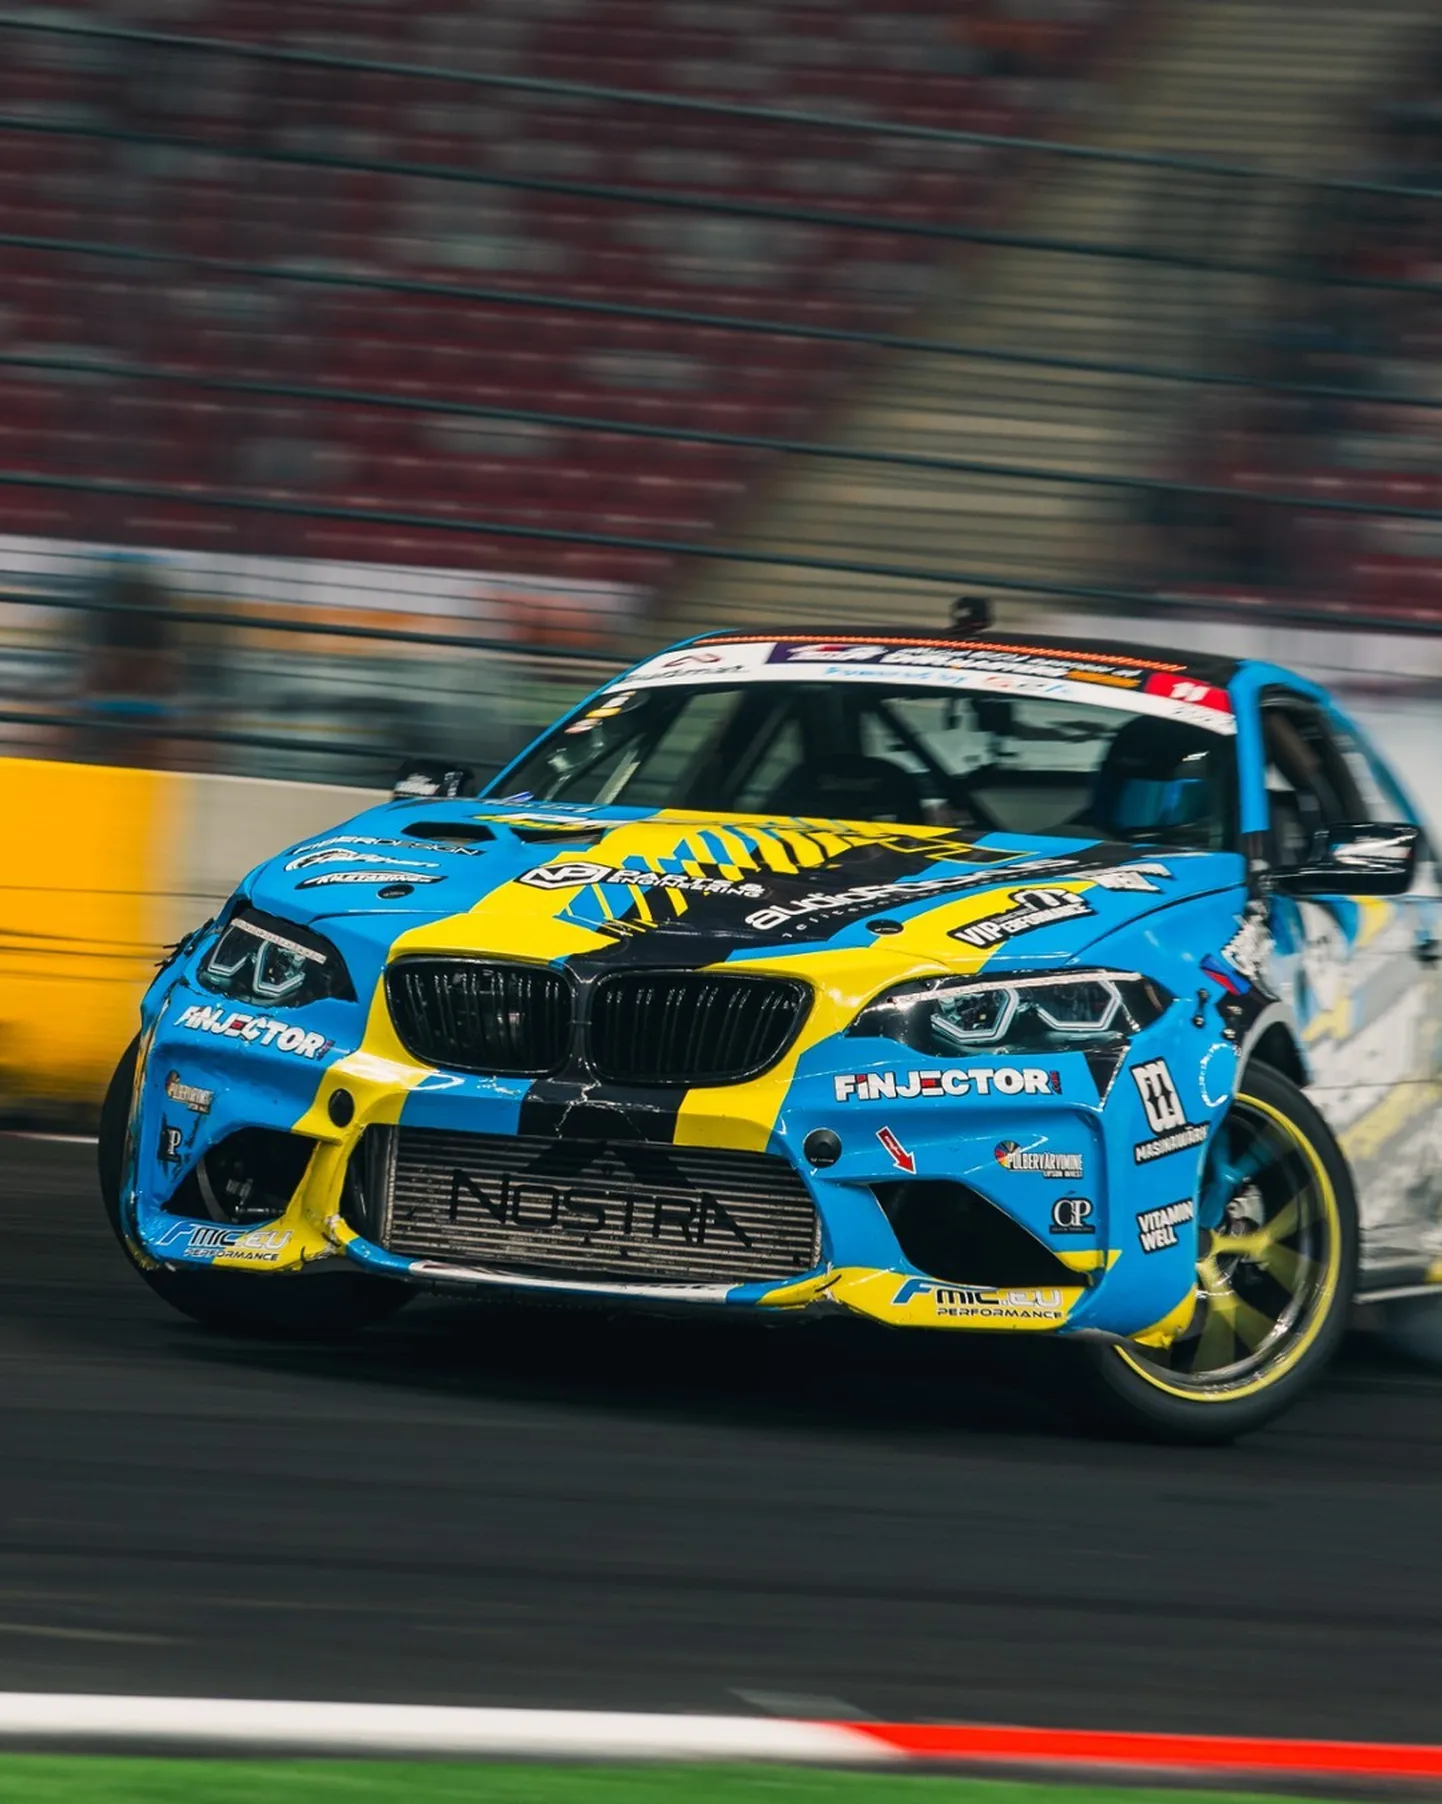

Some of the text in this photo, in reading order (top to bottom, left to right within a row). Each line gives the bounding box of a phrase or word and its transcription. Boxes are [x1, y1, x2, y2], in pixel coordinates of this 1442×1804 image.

[606, 876, 767, 898] ENGINEERING
[612, 868, 736, 888] PARTS
[448, 1168, 753, 1248] NOSTRA
[1137, 1200, 1195, 1233] VITAMIN
[1140, 1226, 1178, 1252] WELL
[184, 1247, 280, 1261] PERFORMANCE
[937, 1307, 1063, 1319] PERFORMANCE
